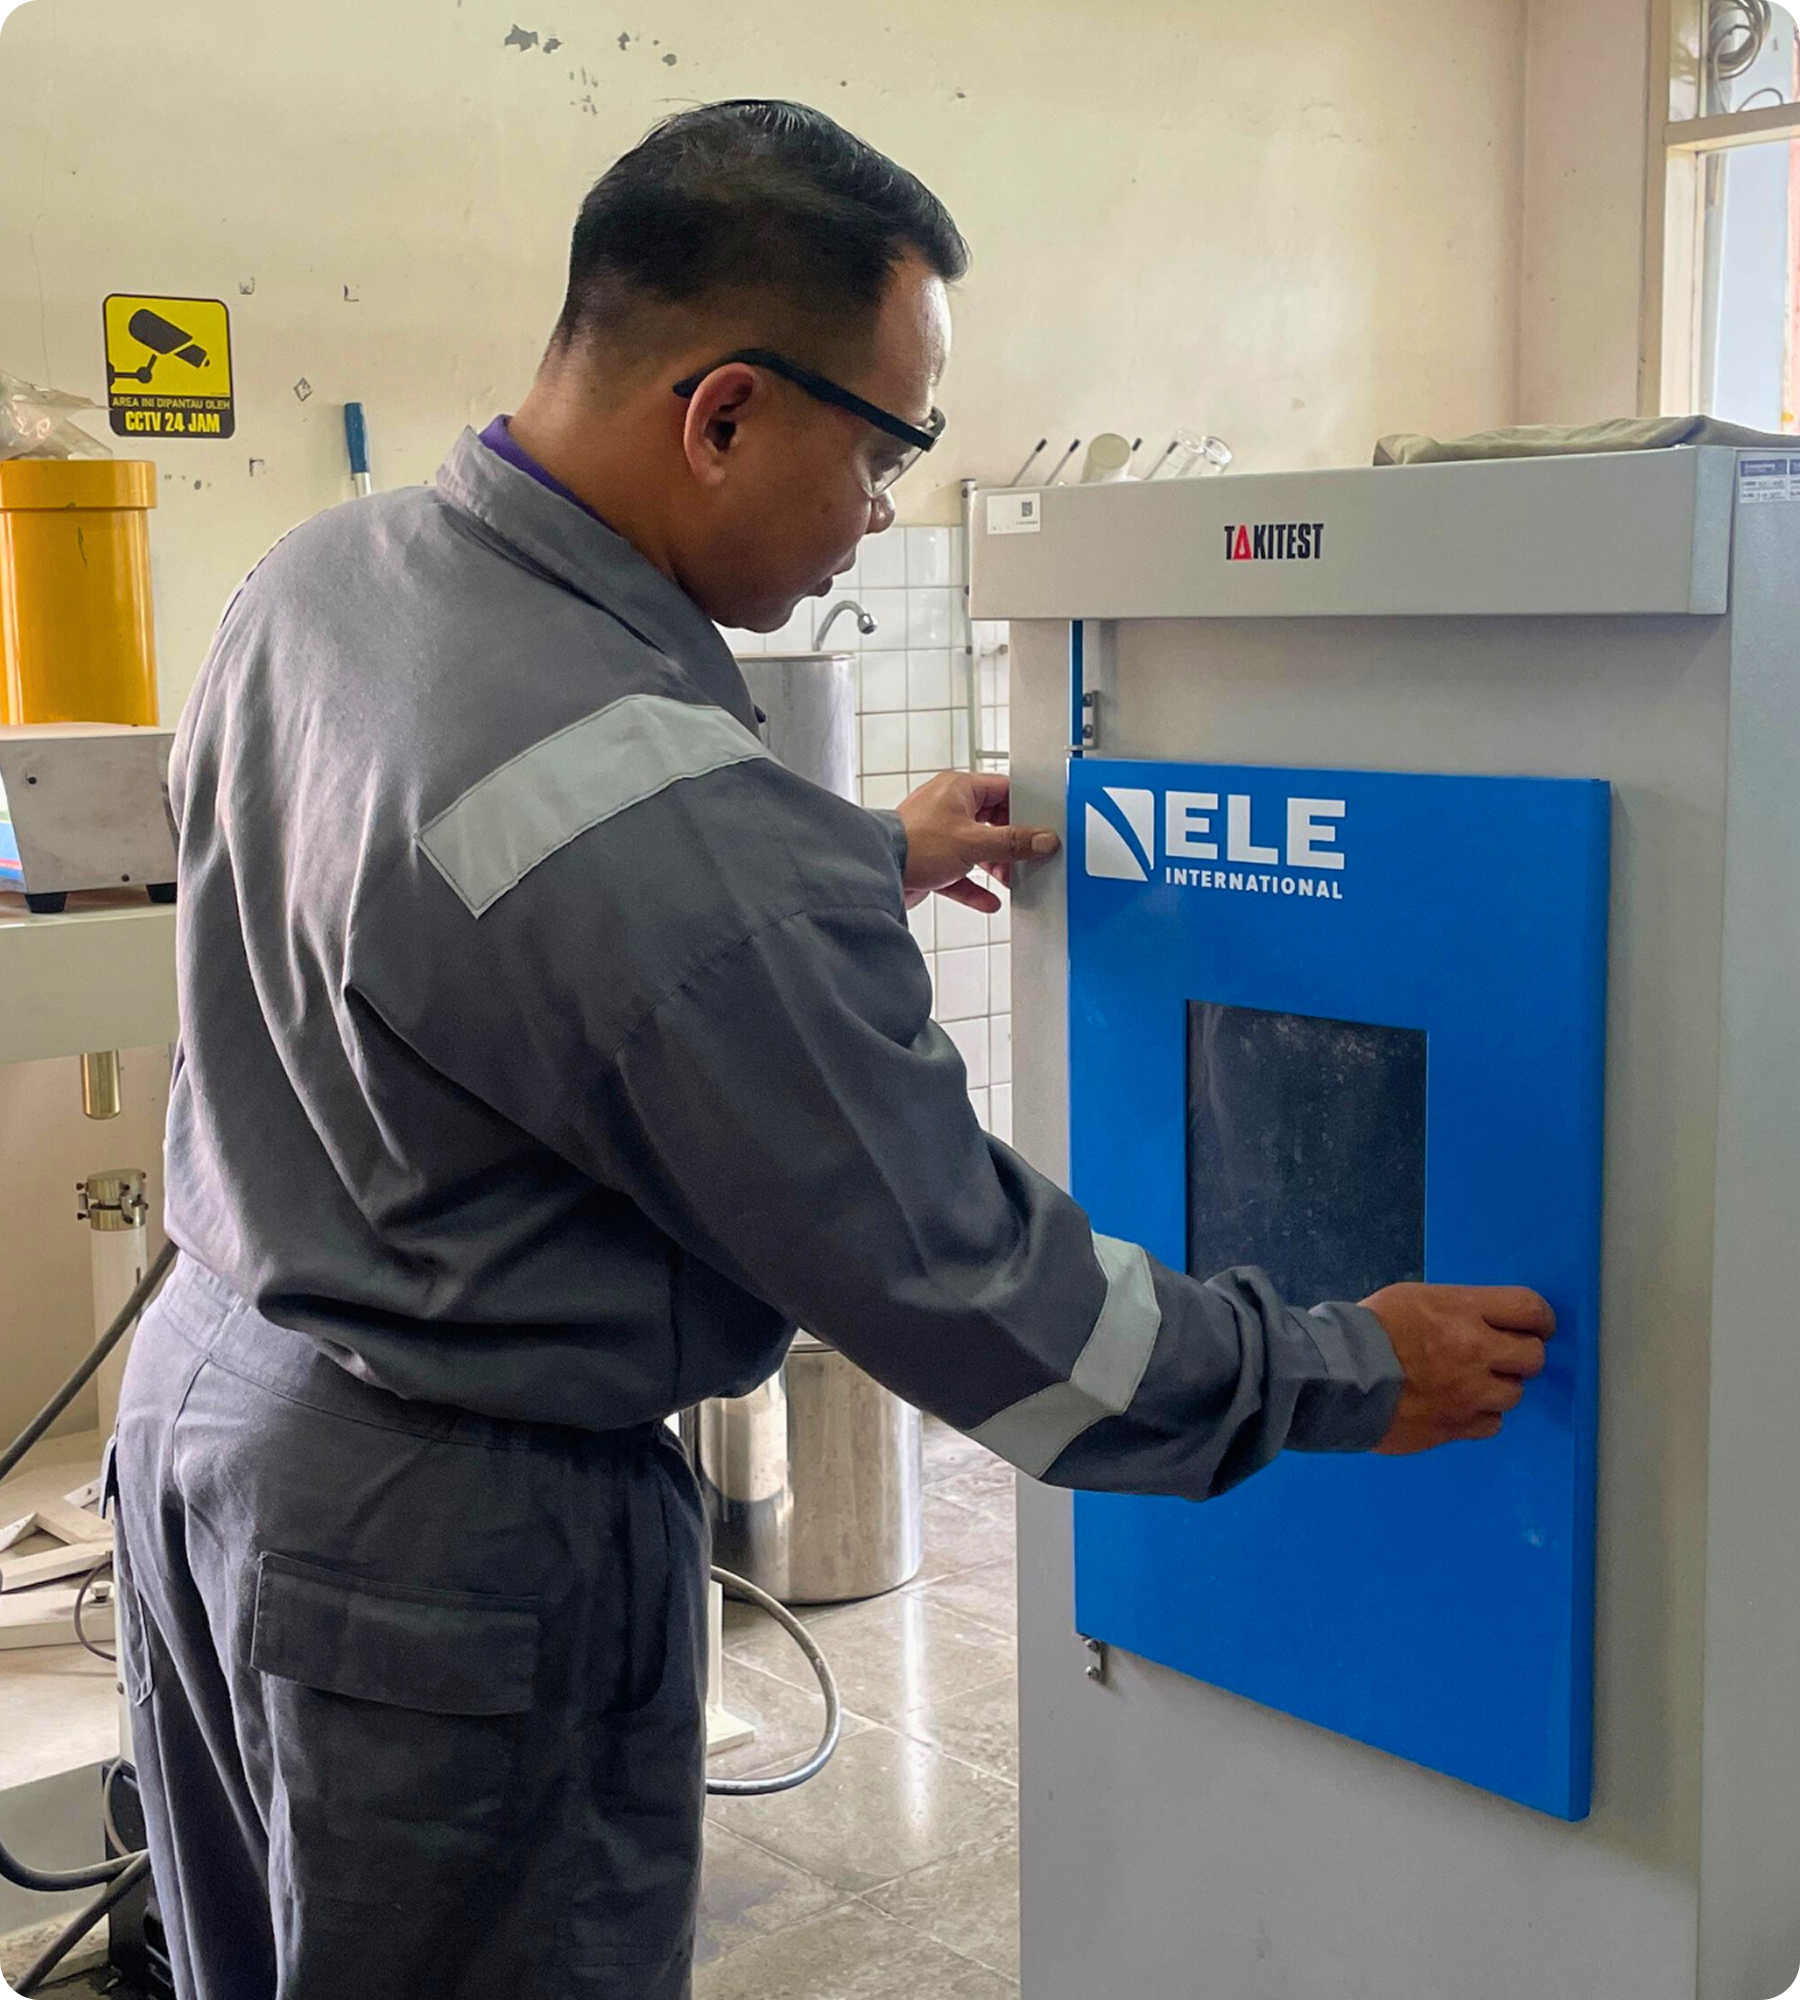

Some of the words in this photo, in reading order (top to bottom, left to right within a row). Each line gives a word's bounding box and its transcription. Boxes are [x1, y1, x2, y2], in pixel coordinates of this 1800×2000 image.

[112, 397, 139, 407] AREA
[141, 397, 154, 407] INI
[156, 398, 203, 409] DIPANTAU
[205, 400, 230, 410] OLEH
[125, 411, 161, 431] CCTV
[164, 412, 185, 432] 24
[188, 413, 220, 433] JAM
[1224, 523, 1324, 560] TAKITEST
[1165, 790, 1346, 870] ELE
[1165, 867, 1343, 900] INTERNATIONAL
